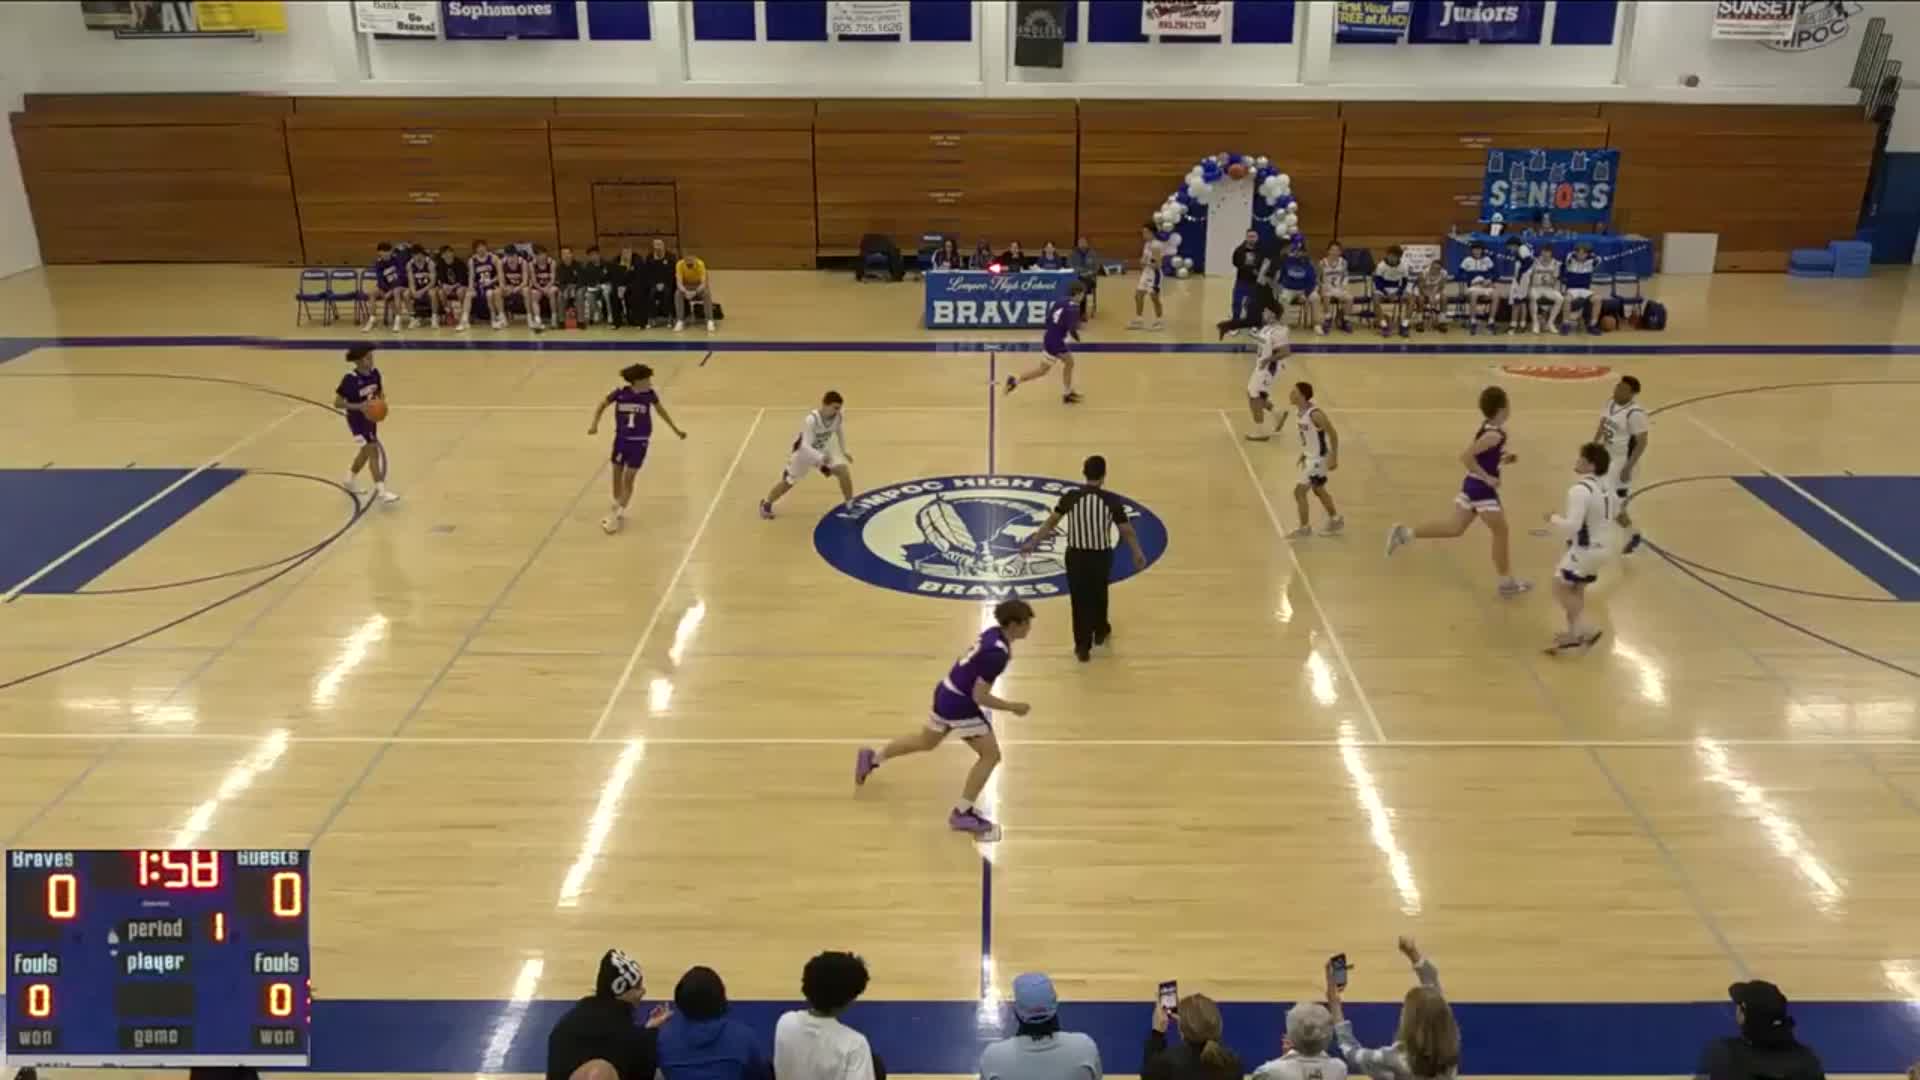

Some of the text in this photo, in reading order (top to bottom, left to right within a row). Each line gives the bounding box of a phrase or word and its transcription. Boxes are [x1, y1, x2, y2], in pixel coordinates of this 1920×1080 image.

[449, 2, 552, 20] Sophomores
[1440, 1, 1519, 26] Juniors
[1718, 1, 1793, 15] SUNSET
[408, 13, 422, 22] Go
[1489, 180, 1610, 209] SENIORS
[946, 274, 1057, 293] Lompoc High School
[932, 300, 1055, 324] BRAVE
[626, 413, 635, 429] 1
[954, 478, 1033, 489] HIGH
[918, 579, 1060, 597] BRAVES
